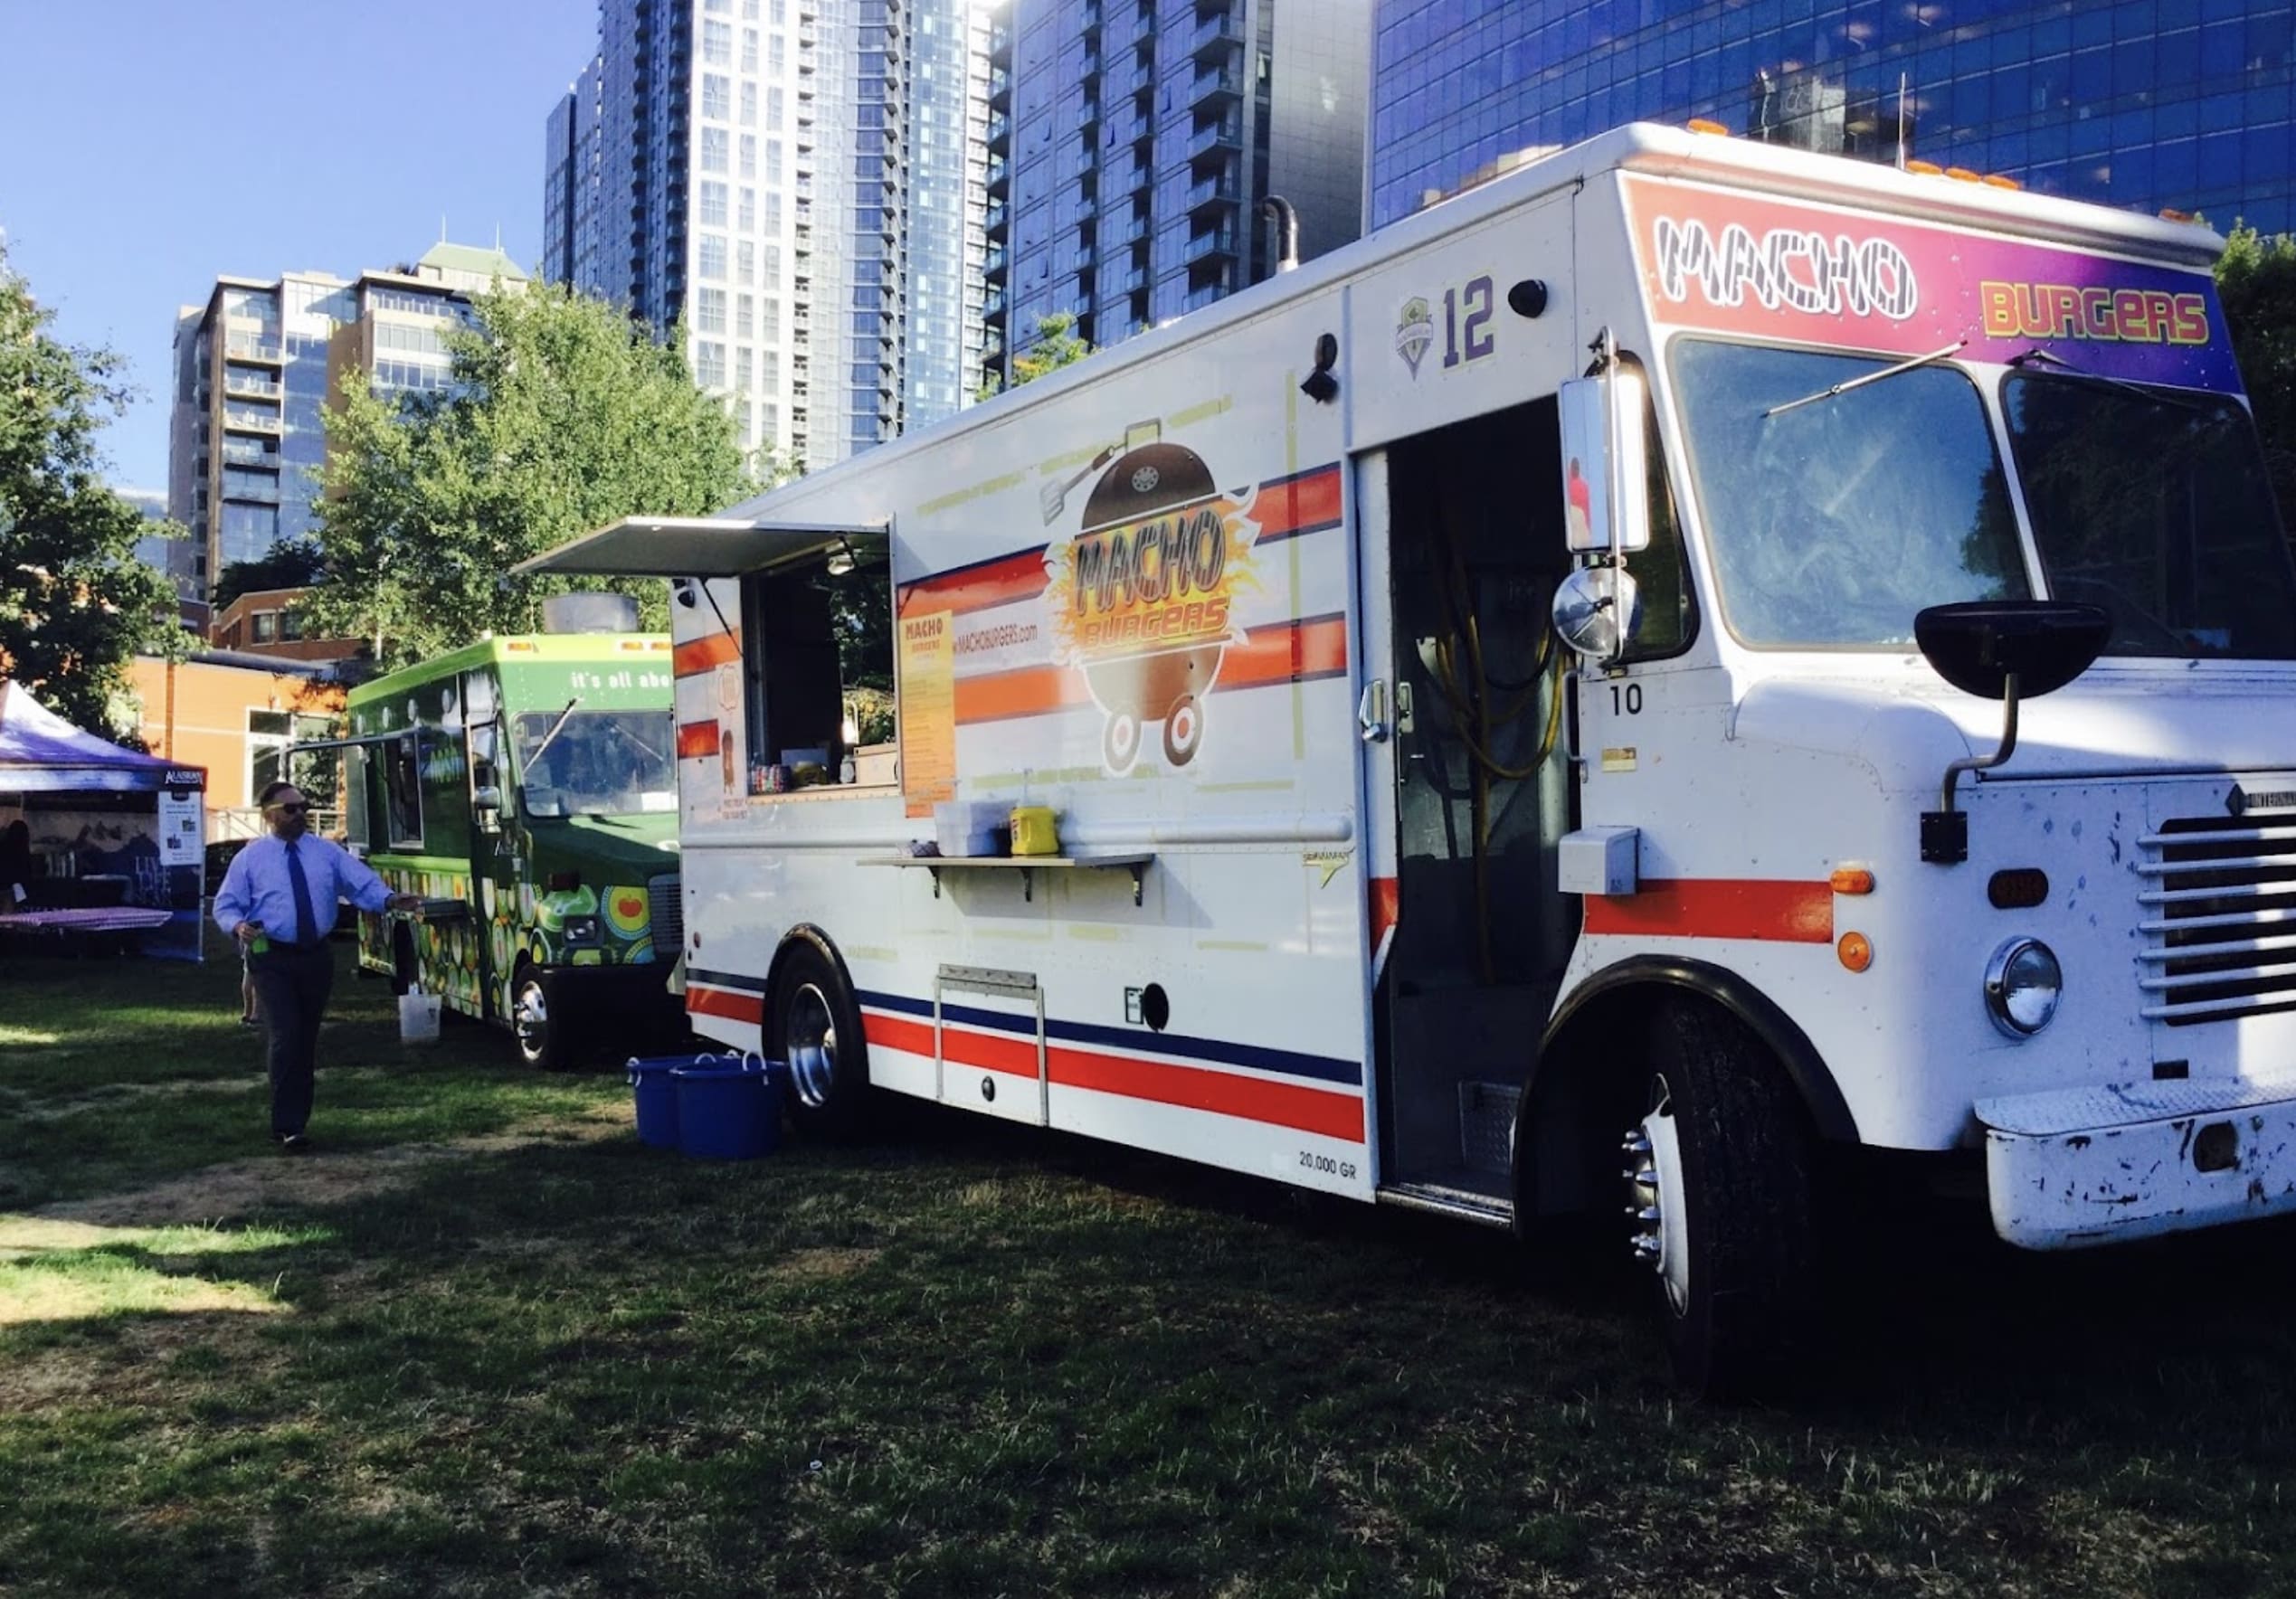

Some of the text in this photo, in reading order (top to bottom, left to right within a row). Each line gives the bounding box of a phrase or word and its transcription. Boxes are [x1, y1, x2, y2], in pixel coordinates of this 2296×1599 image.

[1655, 215, 1918, 319] MACHO
[1443, 275, 1494, 369] 12
[1077, 509, 1225, 616] MACHO
[906, 618, 943, 639] MACHO
[571, 671, 601, 688] it's
[608, 671, 631, 688] all
[1610, 683, 1642, 715] 10
[1300, 1150, 1356, 1179] 20,000 GR
